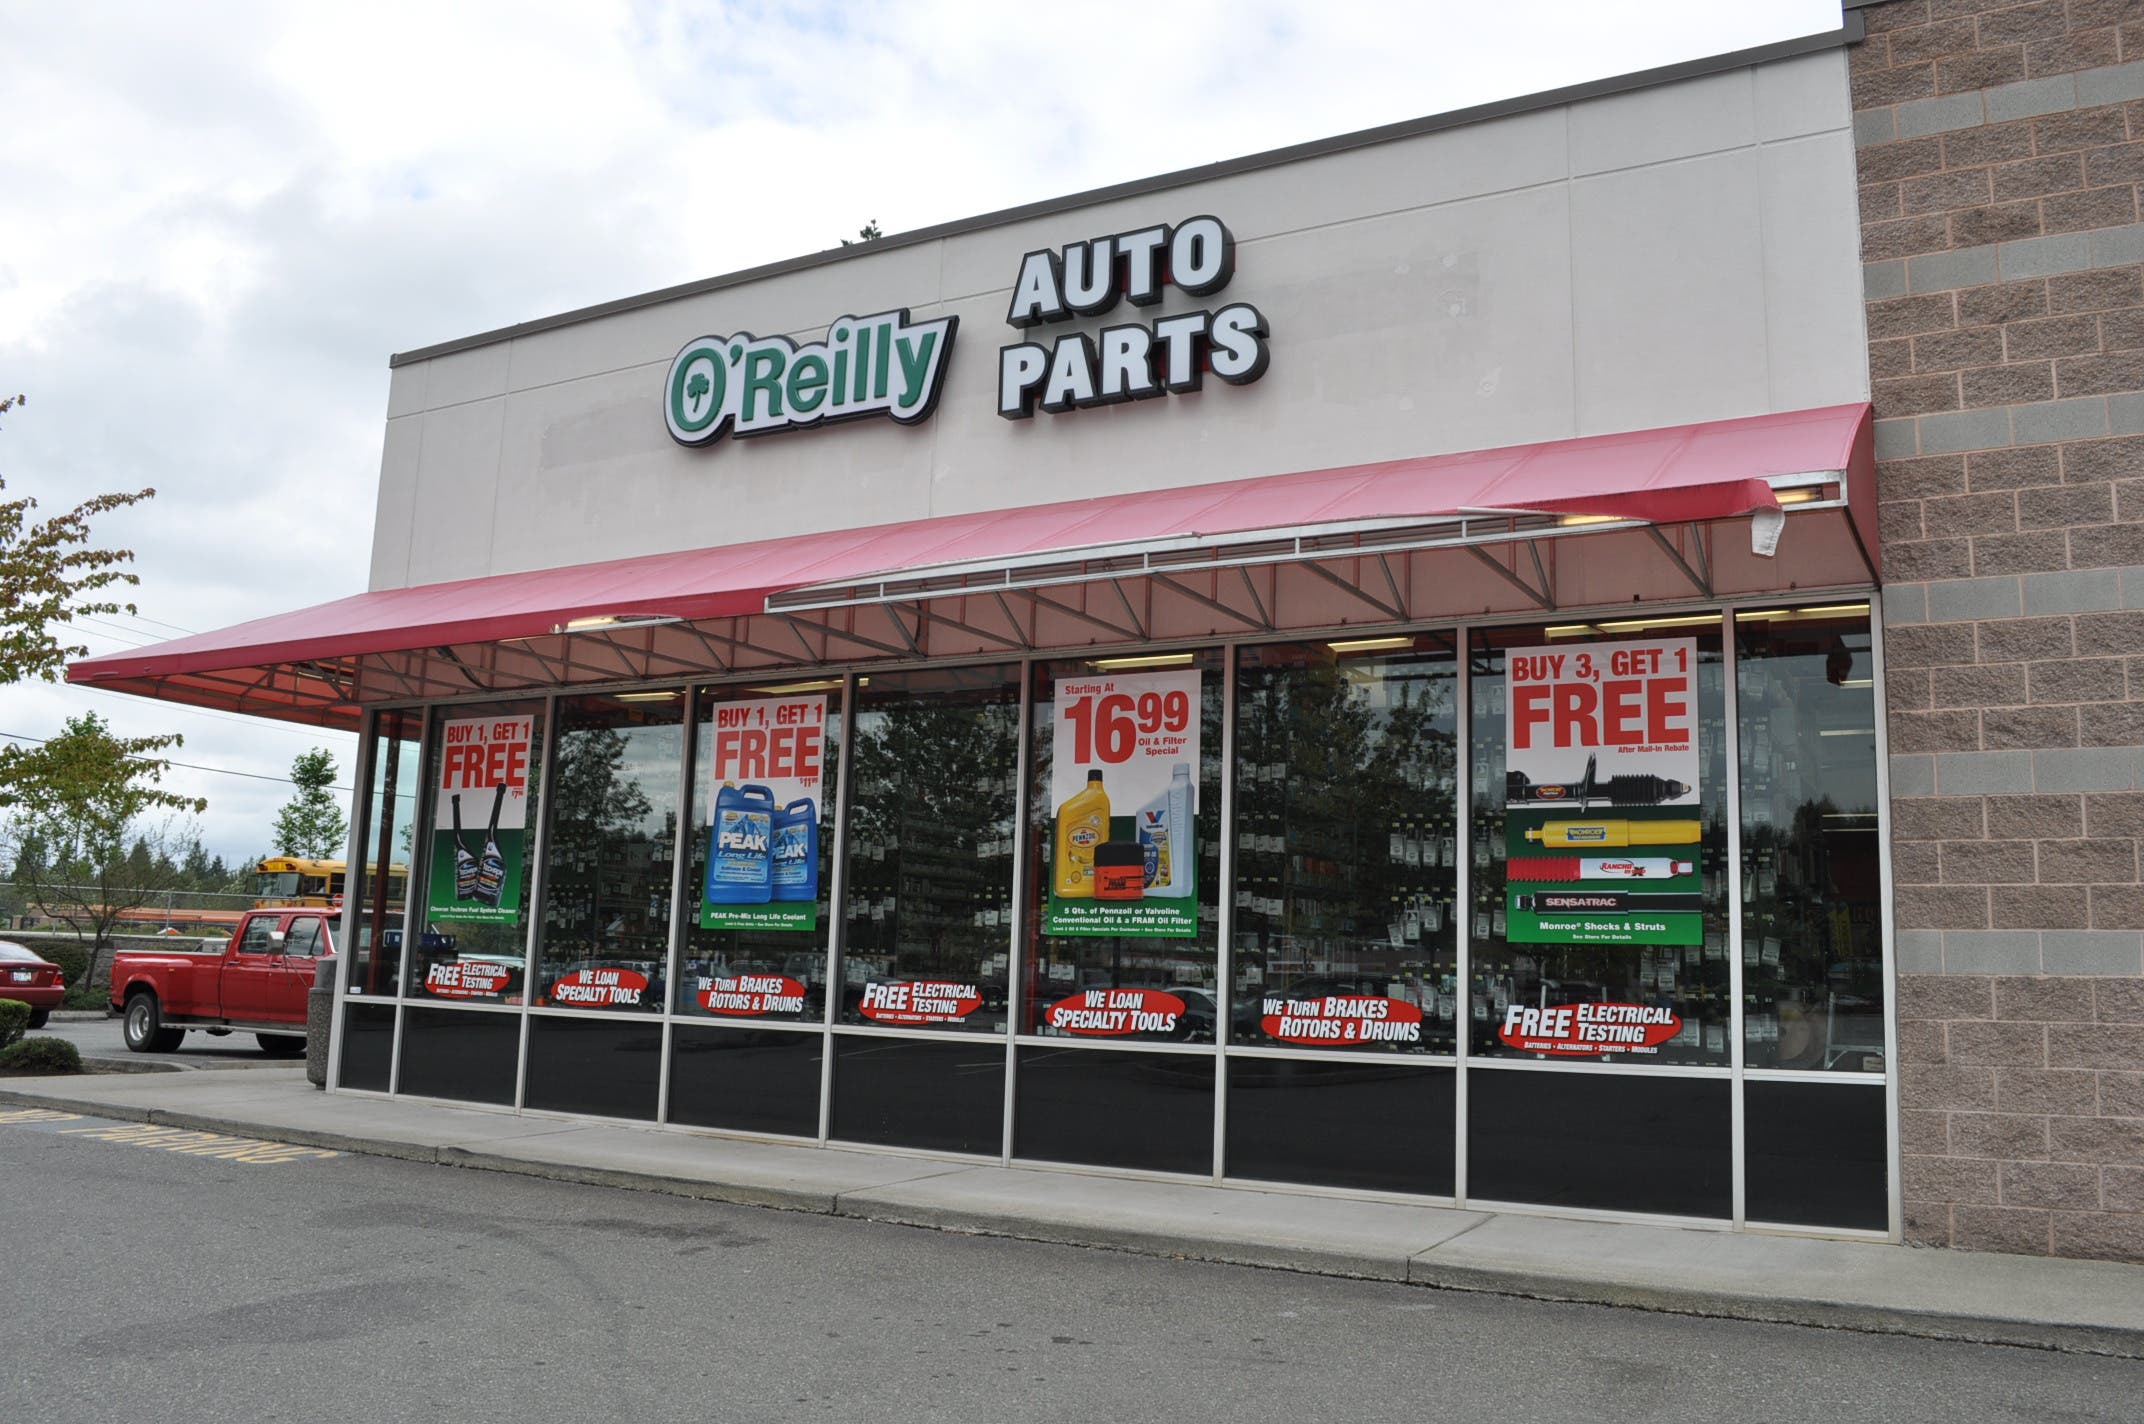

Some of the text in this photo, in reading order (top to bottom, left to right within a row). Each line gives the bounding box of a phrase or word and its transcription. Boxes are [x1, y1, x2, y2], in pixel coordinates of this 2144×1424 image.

[1010, 216, 1232, 324] AUTO
[1001, 304, 1267, 415] PARTS
[671, 319, 940, 432] O'Reilly
[1512, 648, 1687, 683] BUY 3, GET 1
[1065, 682, 1114, 695] Starting At
[718, 704, 822, 730] BUY 1, GET 1
[1513, 677, 1690, 749] FREE
[447, 722, 529, 745] BUY 1, GET 1
[1138, 737, 1187, 746] Oil & Filter
[715, 726, 820, 780] FREE
[1146, 746, 1179, 757] Special
[1637, 745, 1662, 753] Mail-In
[1664, 744, 1689, 752] Rebate
[443, 742, 527, 789] FREE
[719, 831, 768, 851] PEAK
[772, 843, 806, 860] EAK
[1602, 862, 1632, 870] RANCHO
[728, 912, 751, 920] Pre-Mix
[753, 913, 767, 921] Long
[1052, 916, 1101, 924] Conventional
[1103, 916, 1114, 924] Oil
[1116, 916, 1122, 924] &
[1171, 917, 1192, 925] Filter
[1100, 907, 1132, 915] Pennzoil
[1145, 907, 1180, 915] Valvoline
[1584, 922, 1620, 930] Shocks
[1623, 922, 1631, 930] &
[1634, 923, 1666, 931] Struts
[427, 963, 461, 986] FREE
[462, 963, 507, 977] ELECTRICAL
[579, 970, 619, 985] WE LOAN
[462, 976, 494, 990] TESTING
[714, 978, 737, 992] TURN
[739, 976, 782, 994] BRAKES
[912, 982, 977, 999] ELECTRICAL
[556, 984, 640, 1004] SPECIALTY TOOLS
[708, 992, 804, 1012] ROTORS & DRUMS
[862, 982, 909, 1010] FREE
[1085, 990, 1143, 1009] WE LOAN
[912, 998, 958, 1014] TESTING
[1262, 997, 1388, 1019] WE TURN BRAKES
[1576, 1004, 1674, 1025] ELECTRICAL
[1052, 1008, 1177, 1032] SPECIALTY TOOLS
[1279, 1017, 1420, 1041] ROTORS & DRUMS
[1504, 1004, 1573, 1037] FREE
[1578, 1022, 1645, 1042] TESTING
